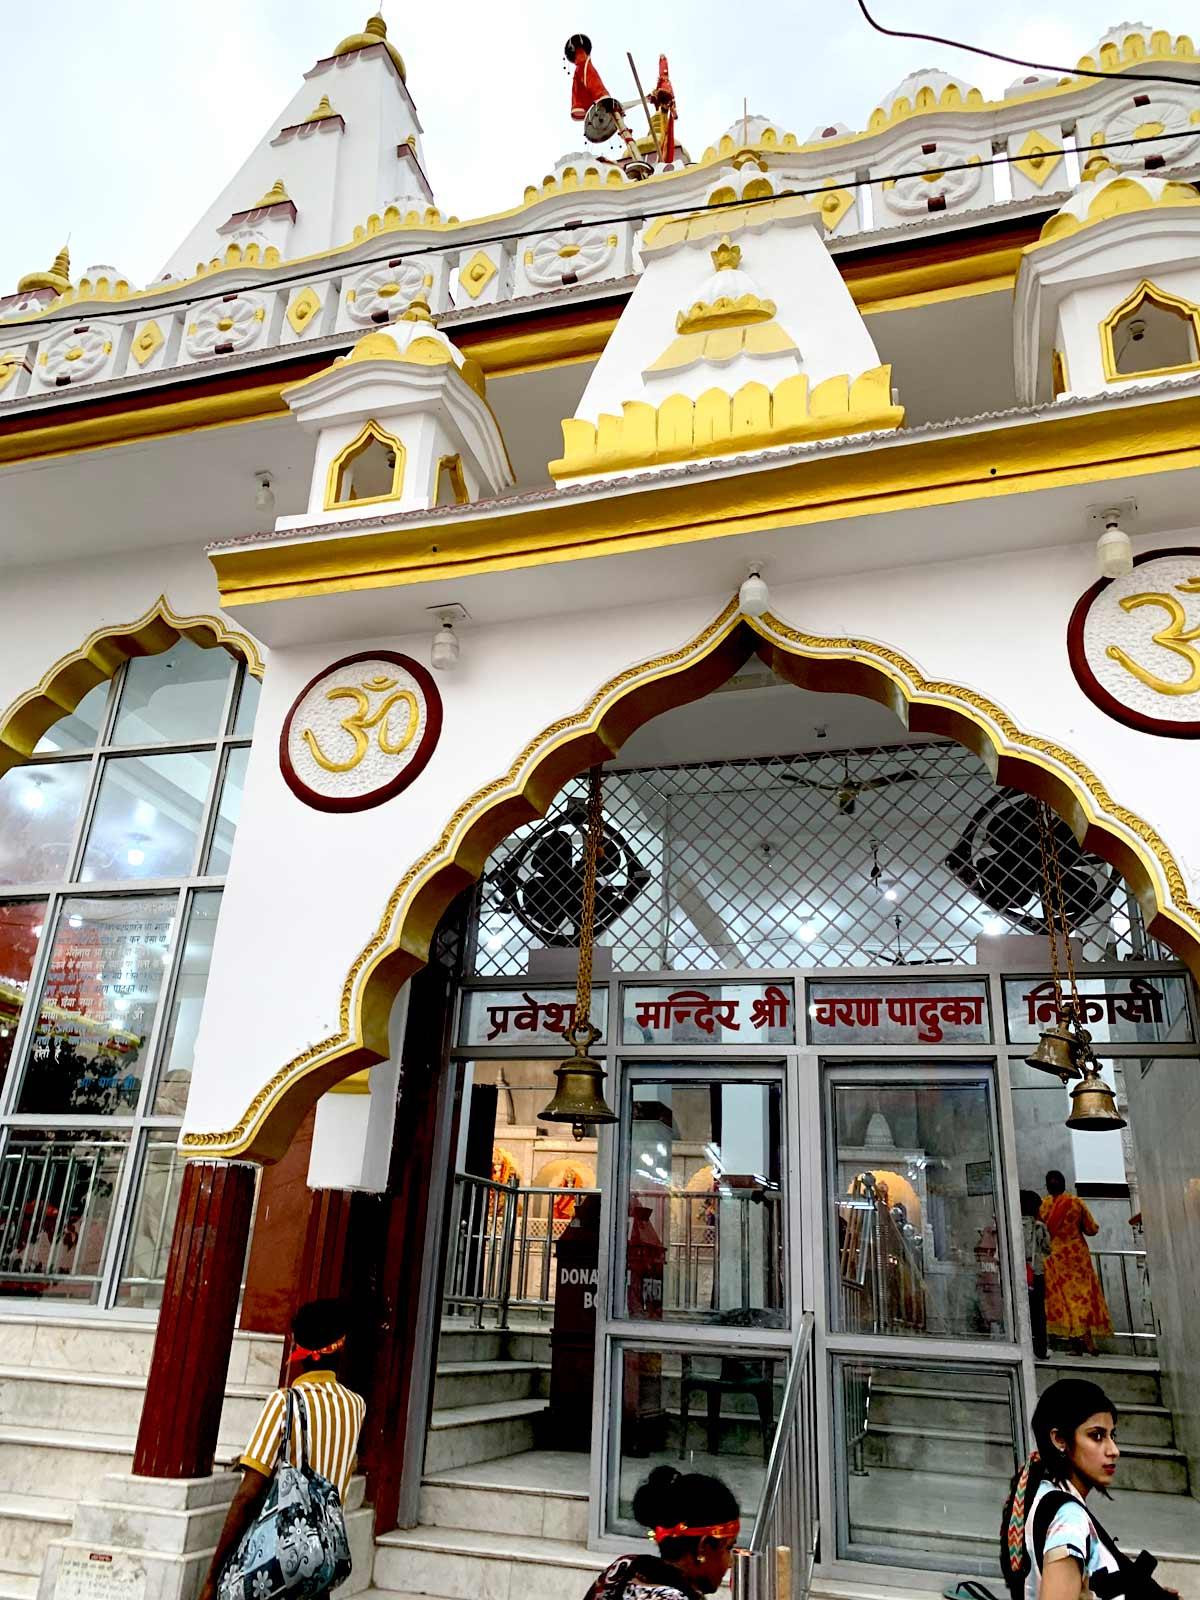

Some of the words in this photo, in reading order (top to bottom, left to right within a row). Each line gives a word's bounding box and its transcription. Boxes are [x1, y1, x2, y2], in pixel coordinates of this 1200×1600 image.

[487, 992, 577, 1041] प्रवेश
[635, 990, 742, 1034] मन्दिर
[749, 985, 791, 1030] श्री
[813, 998, 883, 1027] चरण
[885, 996, 985, 1042] पादुका
[1022, 978, 1164, 1025] निकासी
[561, 1268, 599, 1284] DONA
